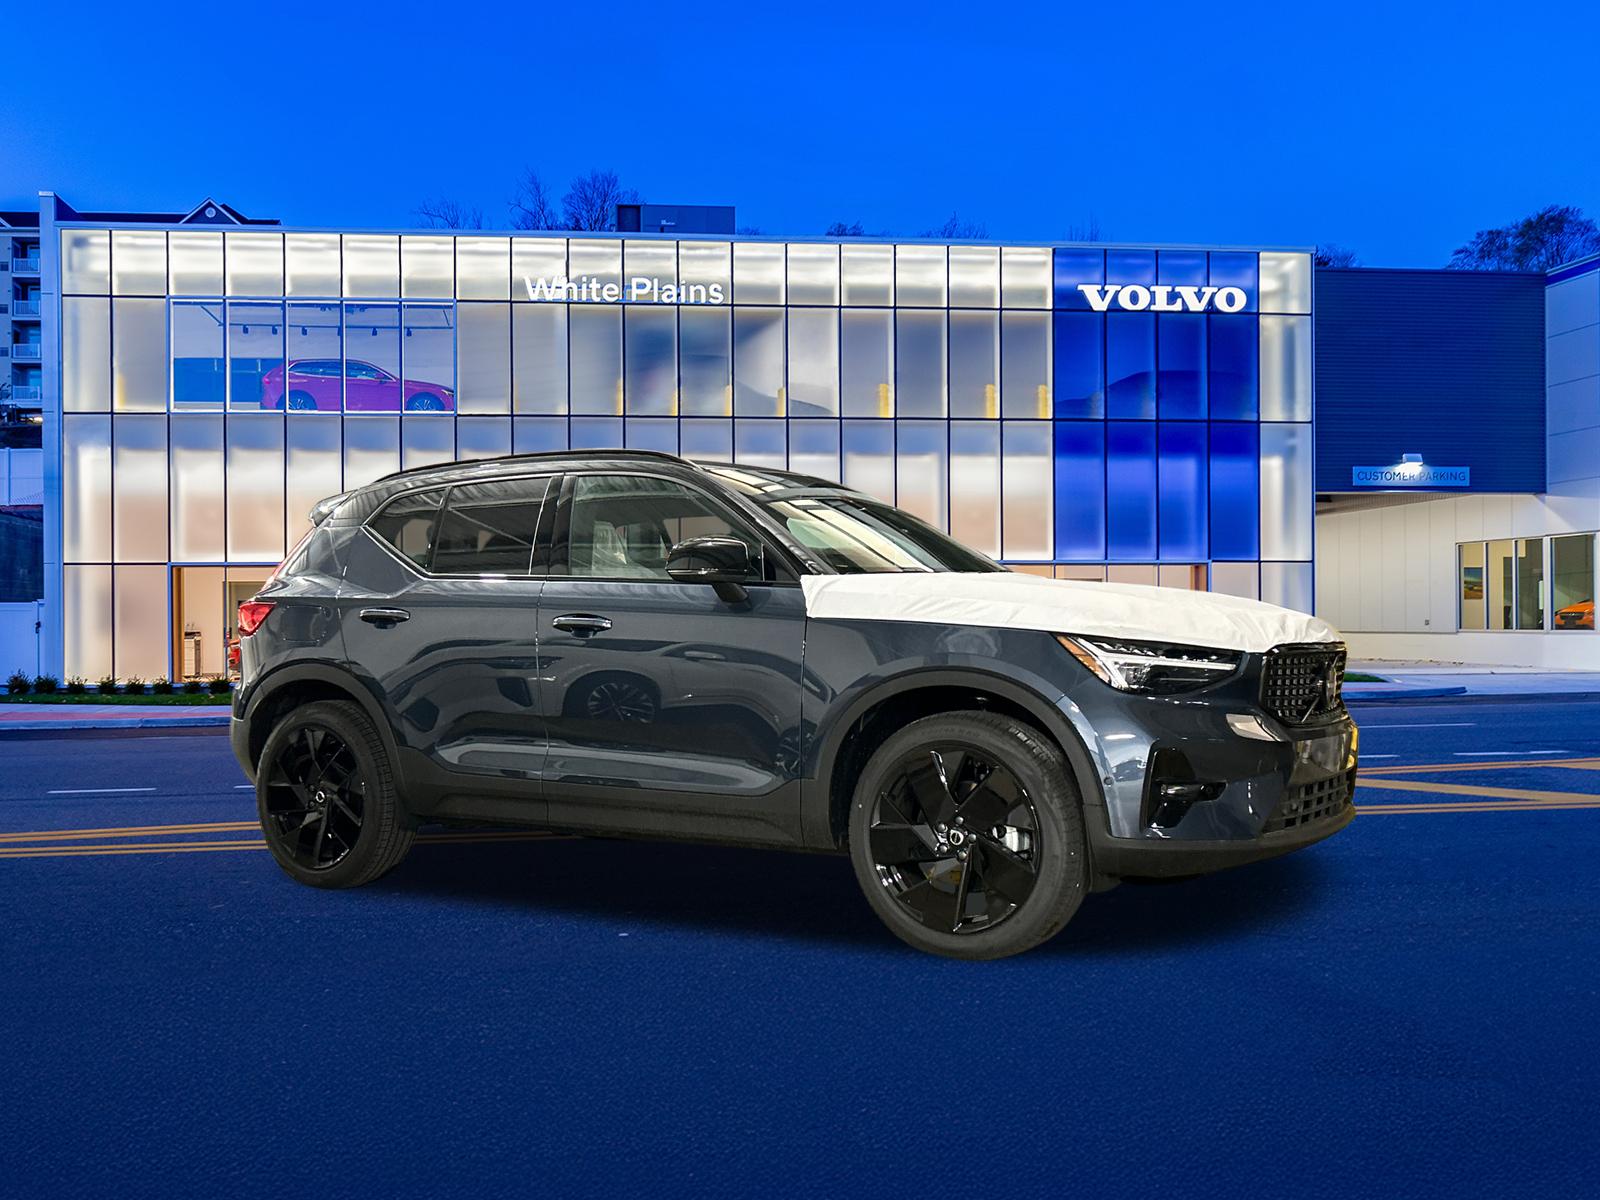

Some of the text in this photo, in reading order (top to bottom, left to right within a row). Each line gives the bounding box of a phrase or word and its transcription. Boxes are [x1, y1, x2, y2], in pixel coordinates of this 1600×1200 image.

[524, 275, 725, 305] White Plains
[1077, 284, 1247, 313] VOLVO
[1419, 471, 1466, 482] PARKING
